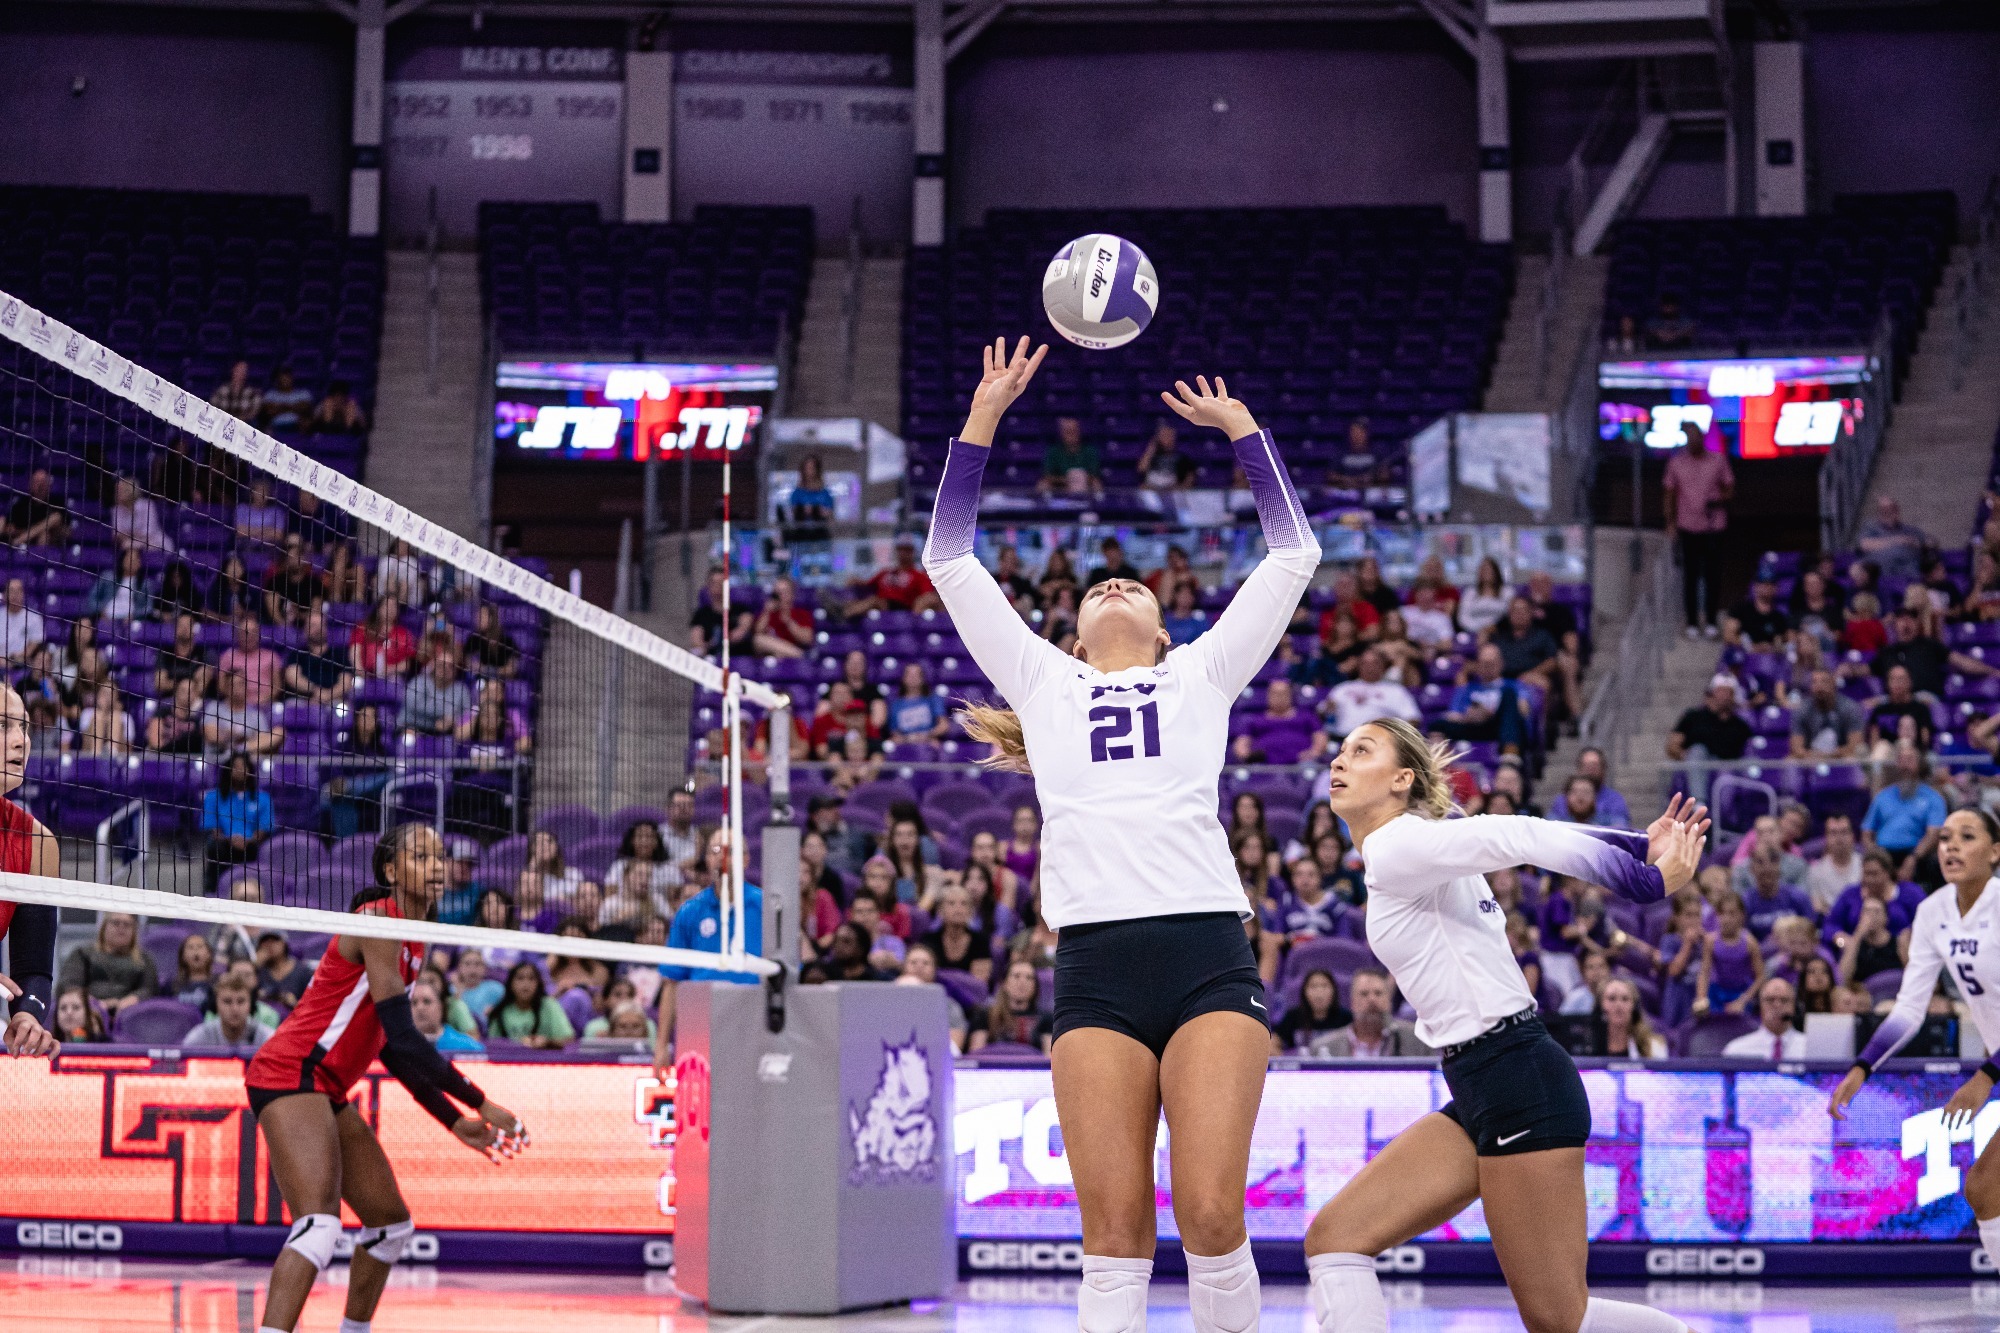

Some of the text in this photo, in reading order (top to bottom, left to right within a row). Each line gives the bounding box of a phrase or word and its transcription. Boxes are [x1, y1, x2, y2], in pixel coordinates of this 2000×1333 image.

[460, 47, 541, 72] MEN'S
[387, 95, 451, 118] 1952
[473, 95, 534, 119] 1953
[768, 99, 824, 122] 1971
[1090, 247, 1113, 299] Baden
[1071, 335, 1108, 349] TCU
[1088, 700, 1162, 763] 21
[1950, 938, 1979, 958] TCU
[1956, 963, 1985, 996] 5
[16, 1221, 123, 1250] GEICO
[968, 1242, 1084, 1270] GEICO
[1645, 1248, 1765, 1275] GEICO
